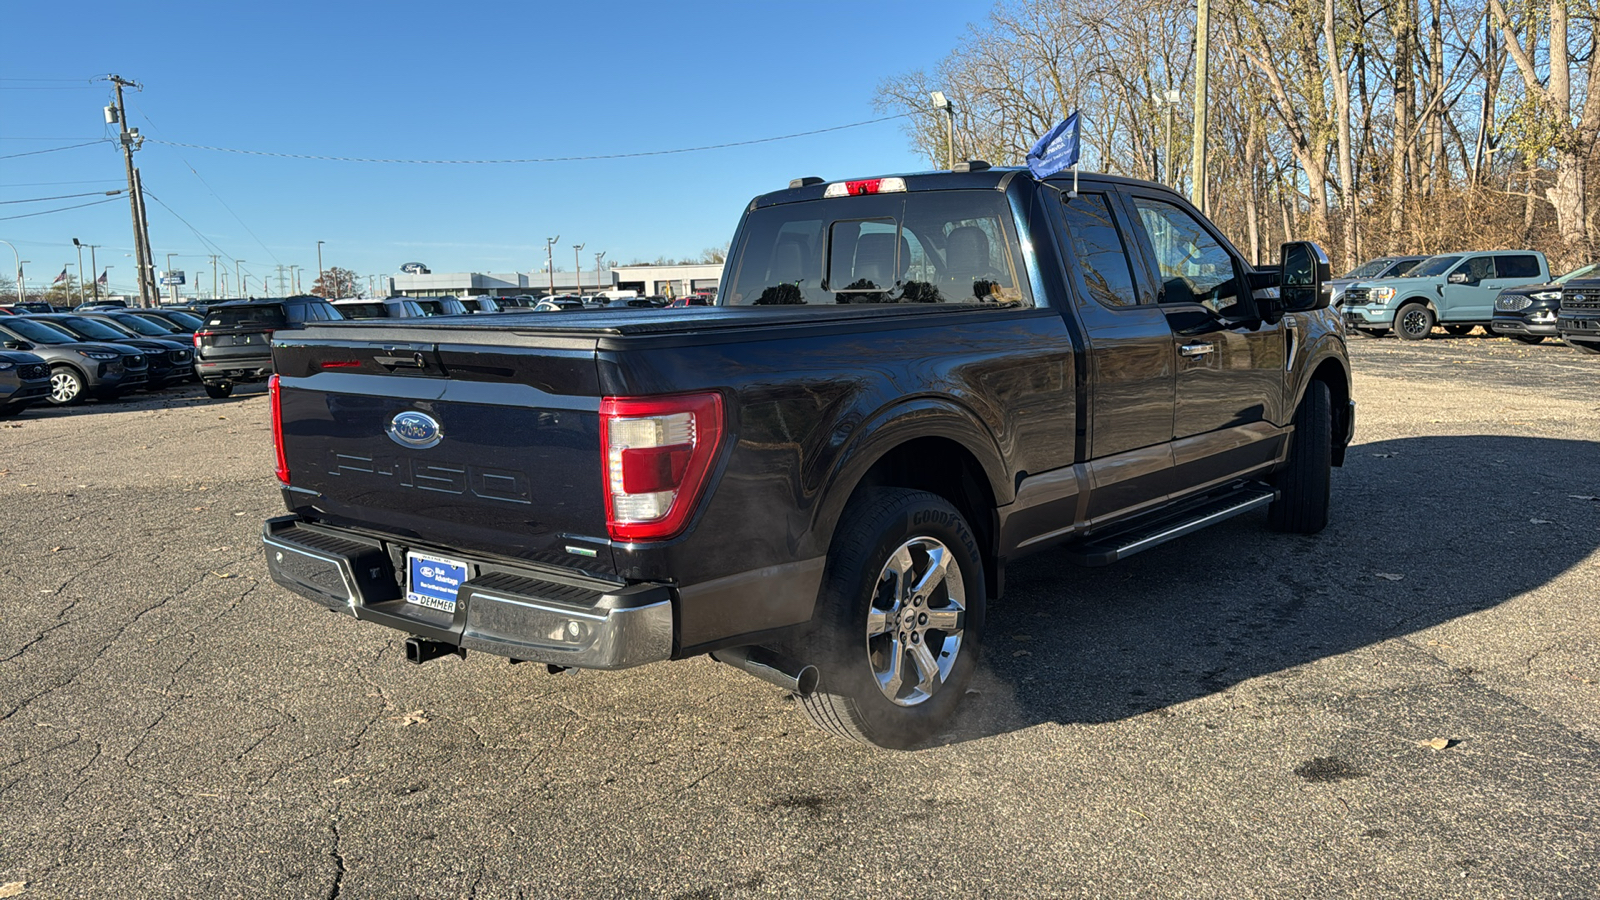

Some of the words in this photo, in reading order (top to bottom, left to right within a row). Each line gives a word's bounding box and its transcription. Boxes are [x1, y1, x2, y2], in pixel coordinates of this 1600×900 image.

[400, 417, 428, 437] Ford
[328, 448, 532, 504] F-150
[913, 509, 979, 564] GOODYEAR
[435, 567, 444, 575] Blue
[435, 575, 458, 586] Advantage
[420, 595, 454, 611] DEMMER
